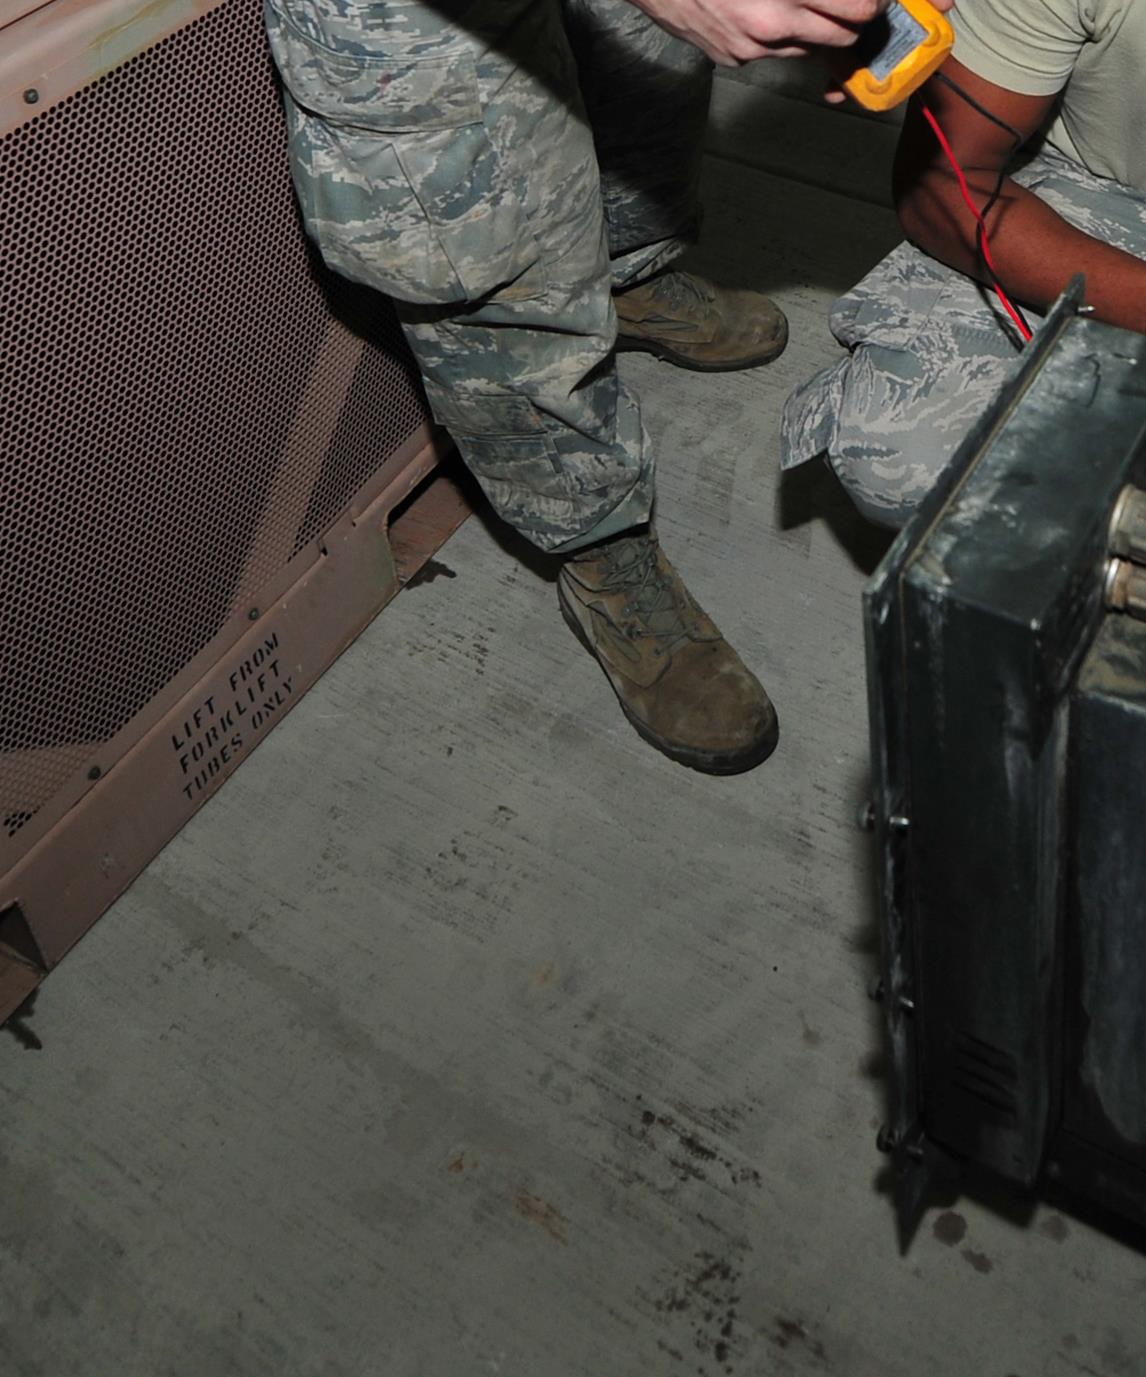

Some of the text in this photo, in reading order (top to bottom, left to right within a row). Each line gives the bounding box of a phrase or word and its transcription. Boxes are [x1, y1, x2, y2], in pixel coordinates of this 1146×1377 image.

[171, 632, 280, 751] LIFT FROM
[182, 677, 293, 801] TUBES ONLY
